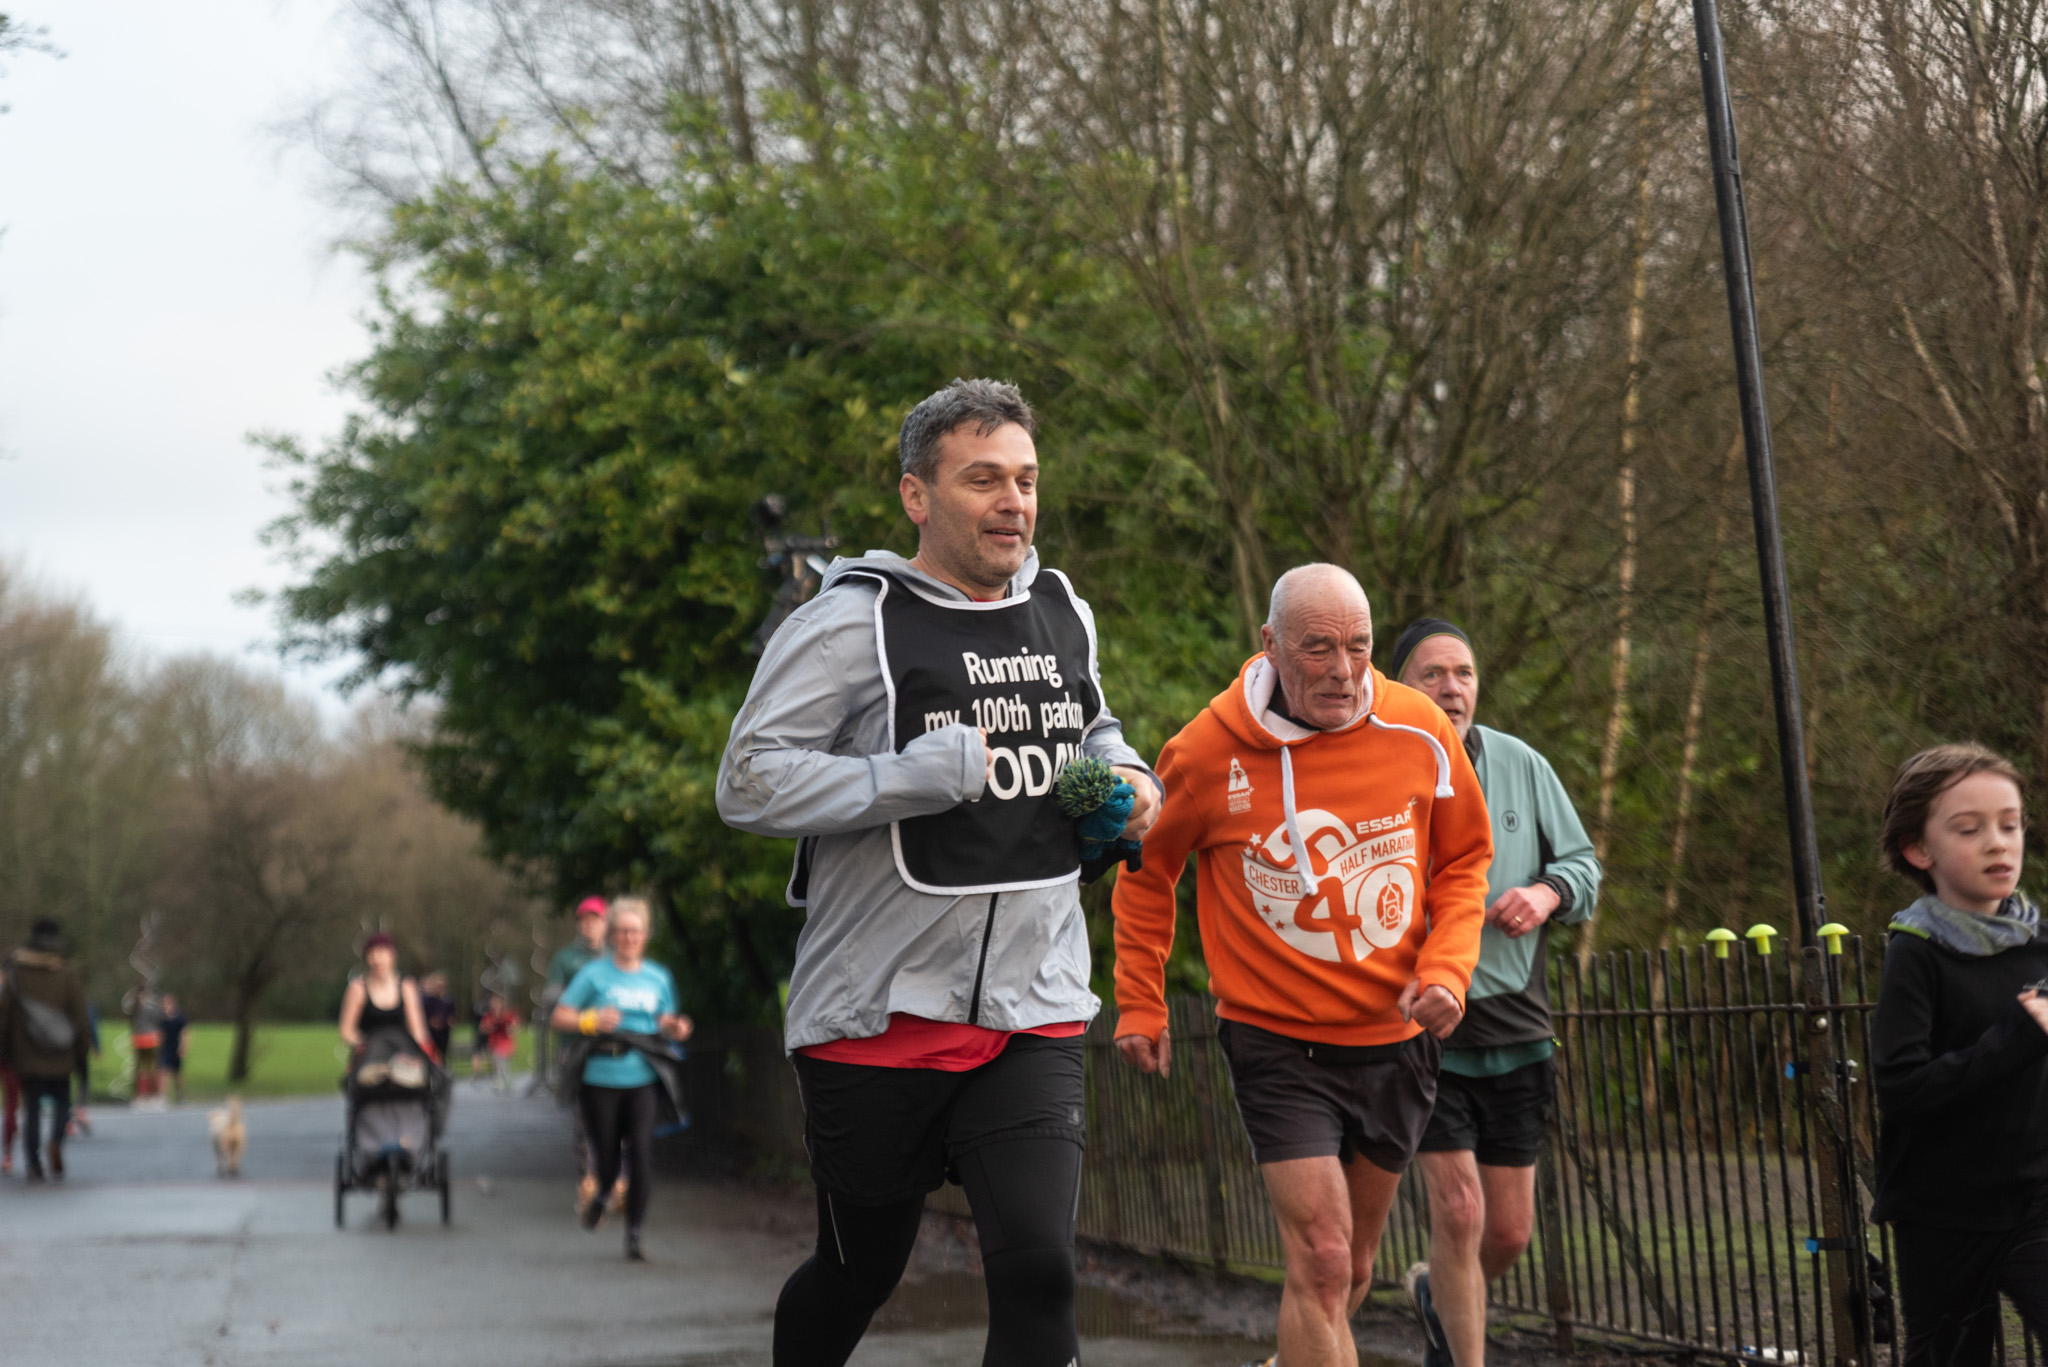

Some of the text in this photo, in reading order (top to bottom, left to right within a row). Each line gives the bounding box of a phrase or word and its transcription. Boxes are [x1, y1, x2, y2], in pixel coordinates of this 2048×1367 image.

[962, 647, 1063, 688] Running
[971, 693, 1032, 734] 100th
[972, 743, 1081, 802] ODA
[1356, 809, 1411, 835] ESSAR
[1249, 865, 1300, 895] CHESTER
[1340, 847, 1367, 878] HALF
